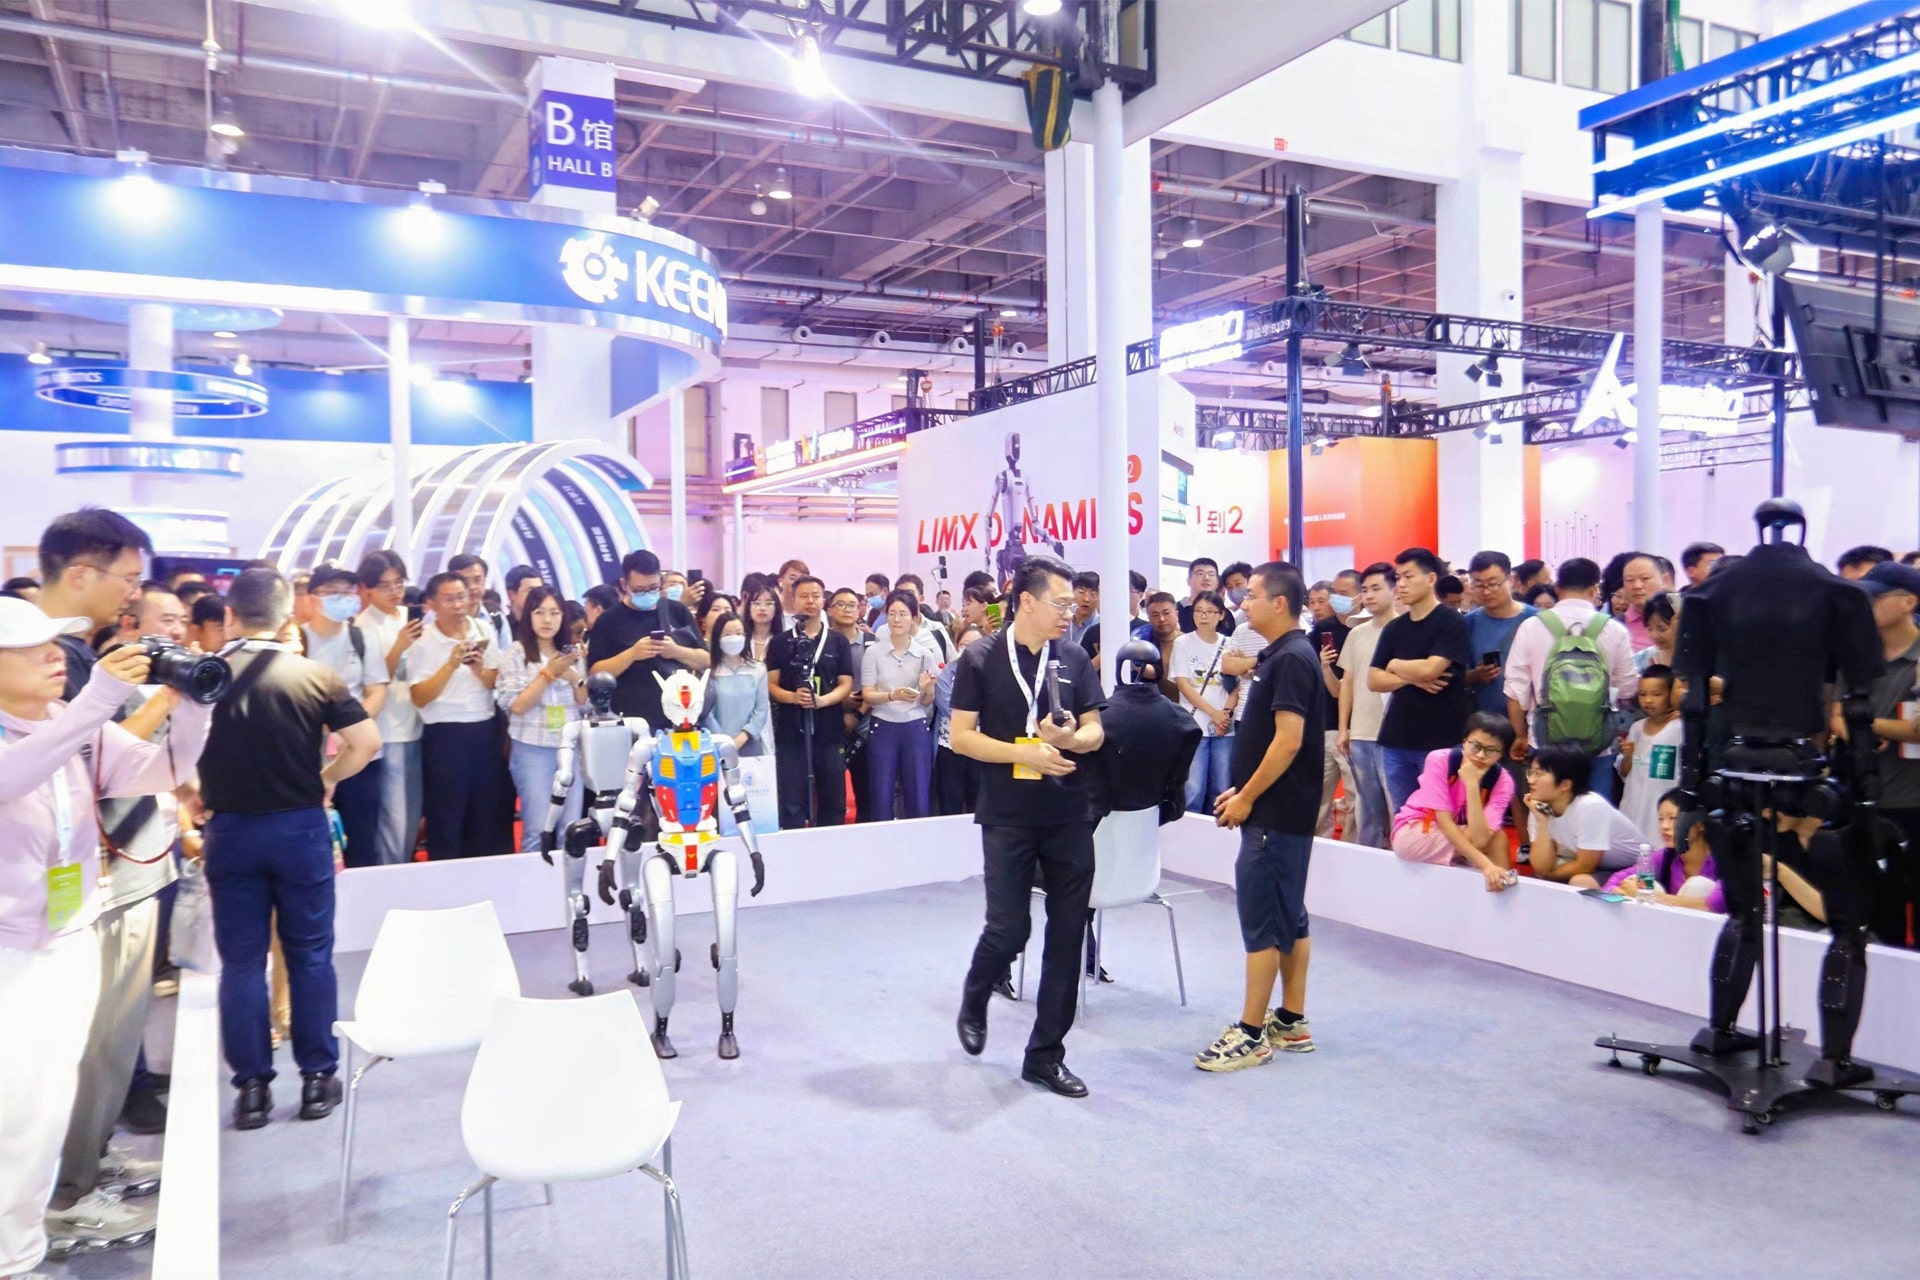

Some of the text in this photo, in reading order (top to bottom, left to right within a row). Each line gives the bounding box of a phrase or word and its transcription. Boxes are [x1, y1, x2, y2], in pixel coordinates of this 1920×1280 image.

[547, 155, 613, 178] HALL B
[917, 491, 1144, 554] LIMX DNAMIS
